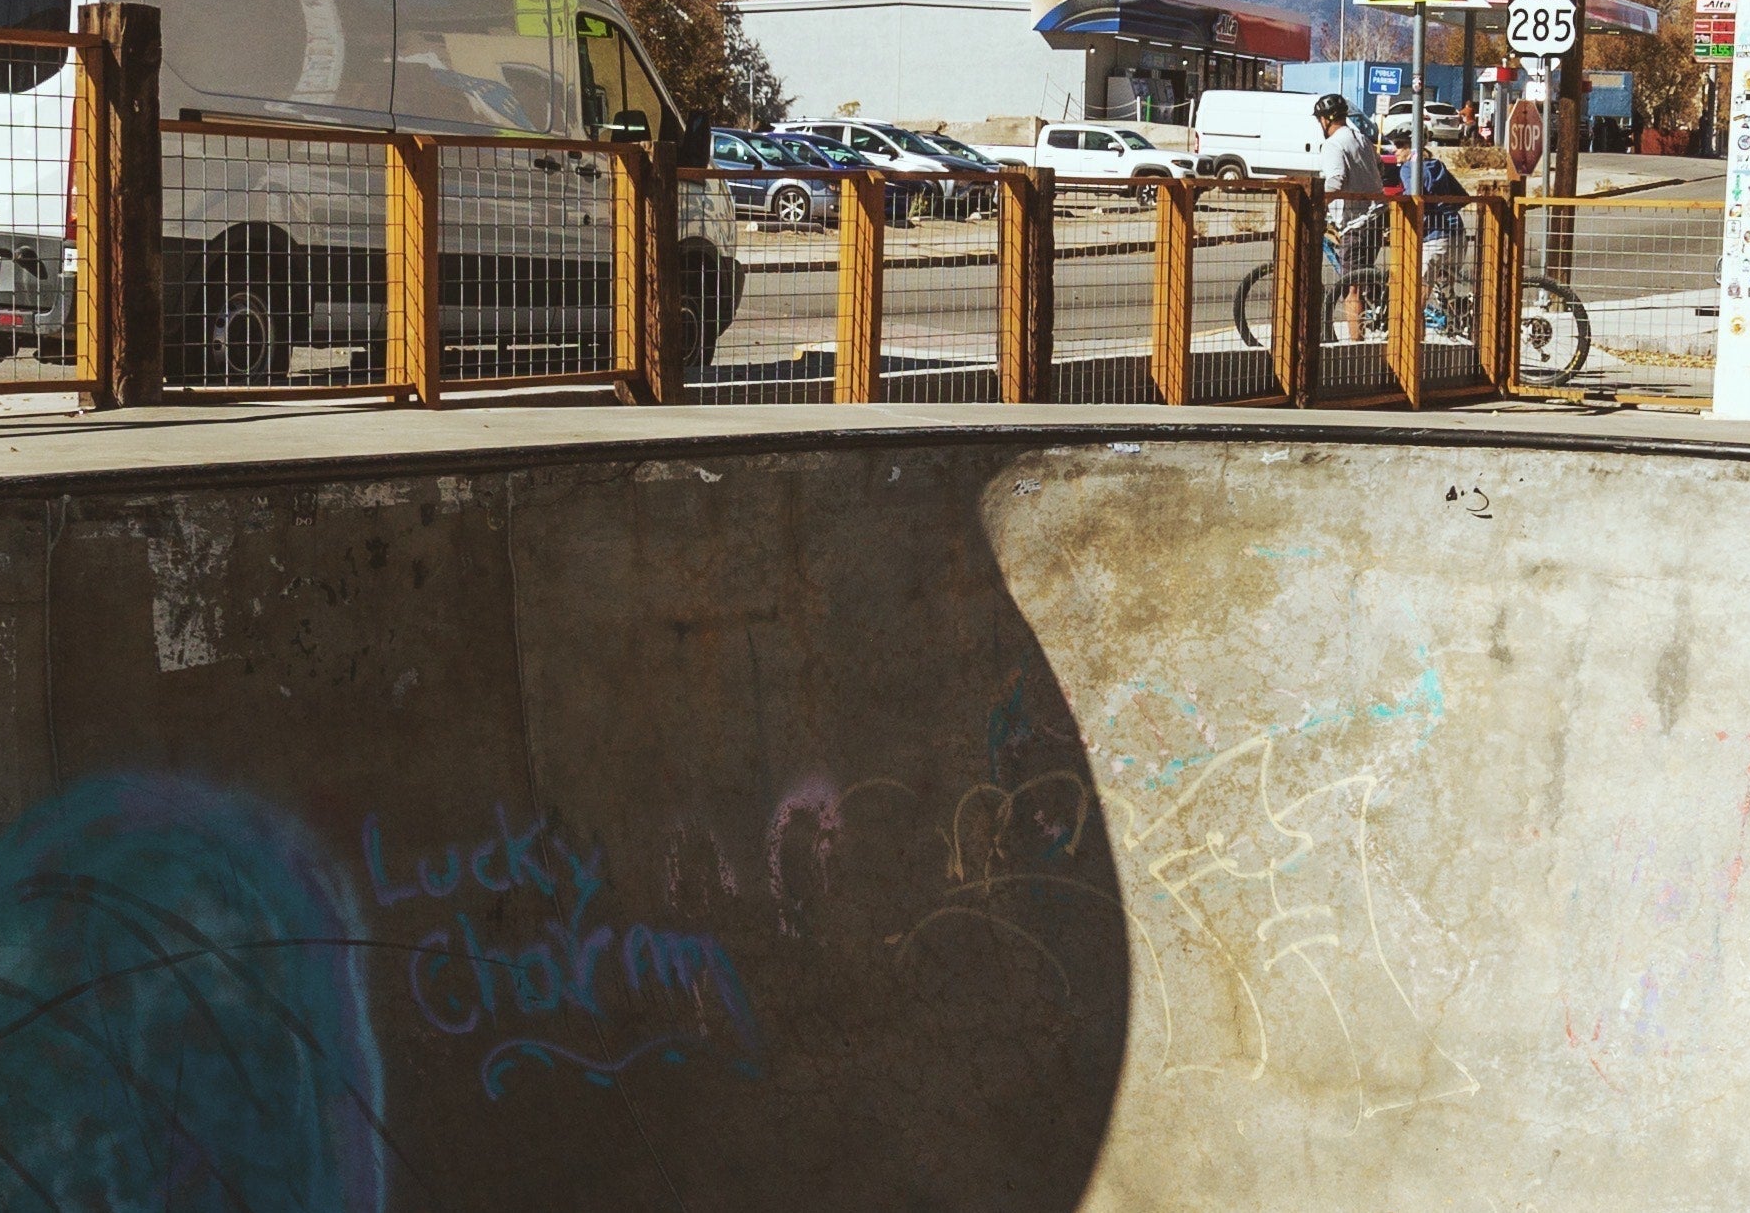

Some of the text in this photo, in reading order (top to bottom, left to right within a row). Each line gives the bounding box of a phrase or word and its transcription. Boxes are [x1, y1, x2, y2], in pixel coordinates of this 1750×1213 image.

[1703, 0, 1731, 9] Alta
[1511, 7, 1572, 42] 285
[1511, 123, 1541, 152] STOP
[361, 802, 606, 926] Lucky
